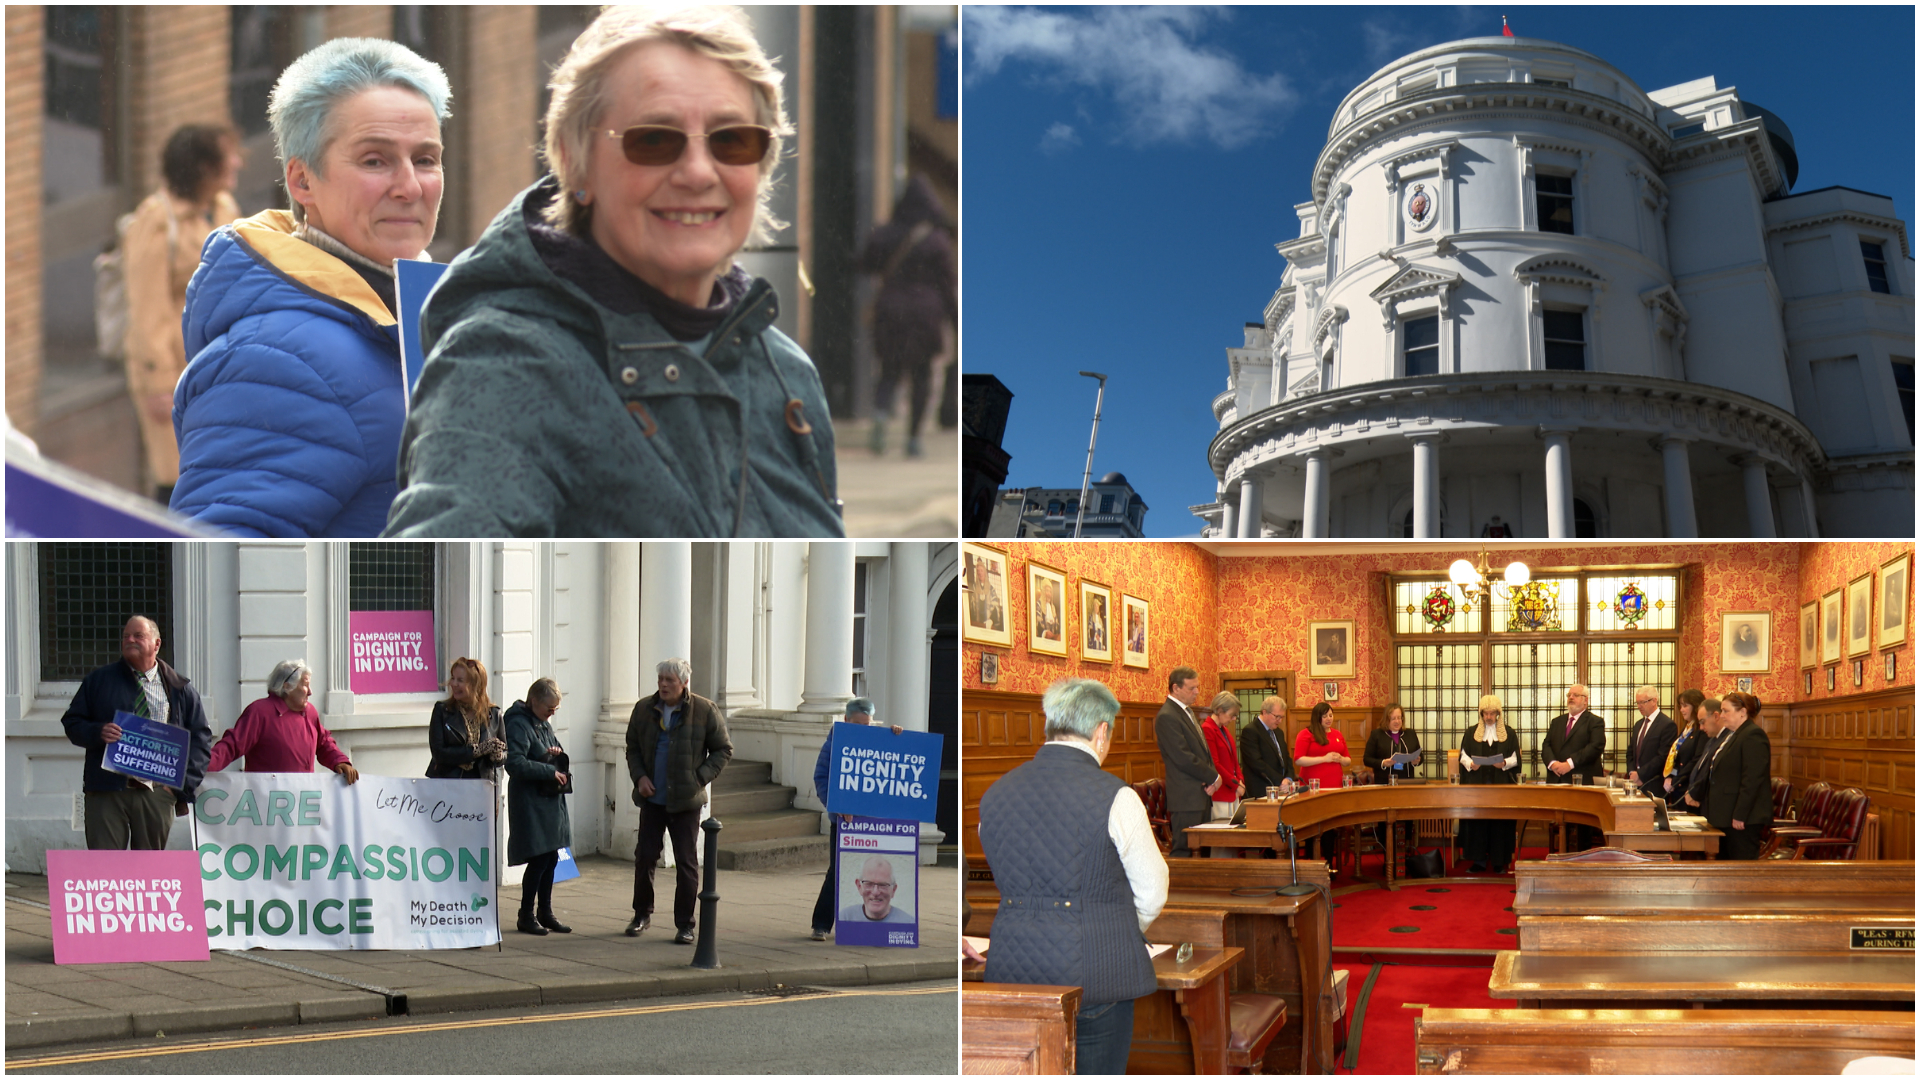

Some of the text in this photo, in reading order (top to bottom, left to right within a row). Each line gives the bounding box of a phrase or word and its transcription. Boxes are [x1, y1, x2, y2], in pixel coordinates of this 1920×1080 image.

[353, 632, 422, 641] CAMPAIGN FOR
[353, 641, 422, 657] DIGNITY
[354, 656, 429, 673] IN DYING.
[117, 743, 178, 766] TERMINALLY
[120, 733, 179, 756] ACT FOR THE
[842, 746, 926, 765] CAMPAIGN FOR
[114, 754, 176, 777] SUFFERING
[840, 756, 925, 782] DIGNITY
[839, 774, 928, 800] IN DYING.
[195, 788, 322, 827] CARE
[376, 788, 488, 823] Let Me Choose
[841, 822, 916, 833] CAMPAIGN FOR
[843, 836, 878, 848] Simon
[199, 842, 490, 882] COMPASSION
[64, 879, 182, 891] CAMPAIGN FOR
[64, 891, 182, 913] DIGNITY
[410, 900, 468, 914] My Death
[66, 912, 193, 934] IN DYING.
[203, 898, 374, 936] CHOICE
[410, 914, 483, 927] My Decision
